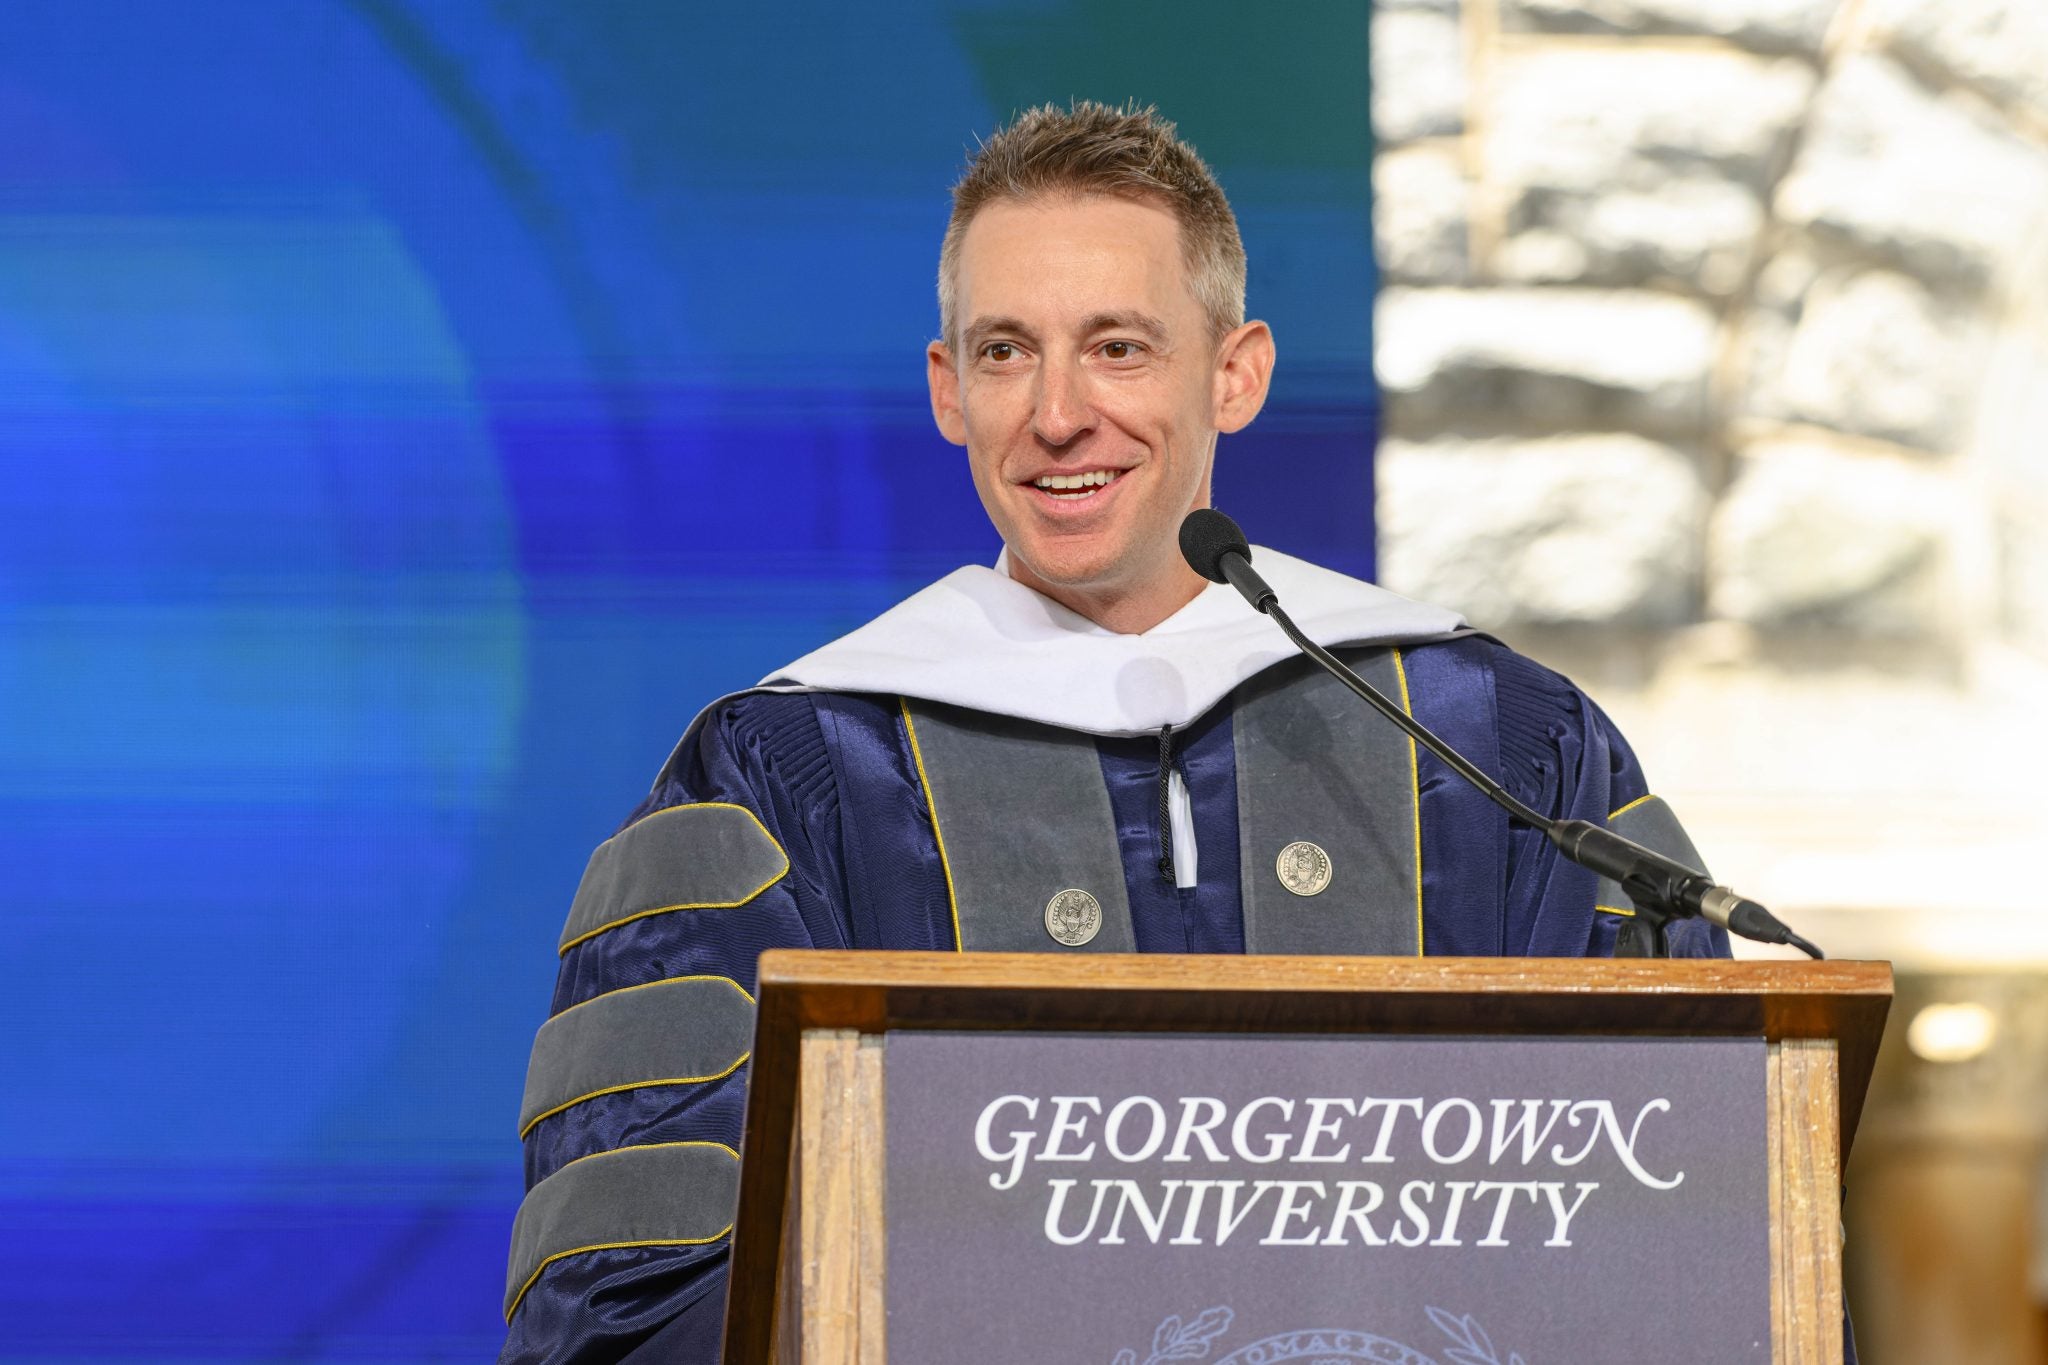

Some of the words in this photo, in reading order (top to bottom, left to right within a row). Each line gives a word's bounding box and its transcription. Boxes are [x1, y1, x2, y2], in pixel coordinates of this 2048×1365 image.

[974, 1094, 1685, 1190] GEORGETOWN
[1044, 1179, 1600, 1247] UNIVERSITY
[1219, 1333, 1375, 1365] OMACI
